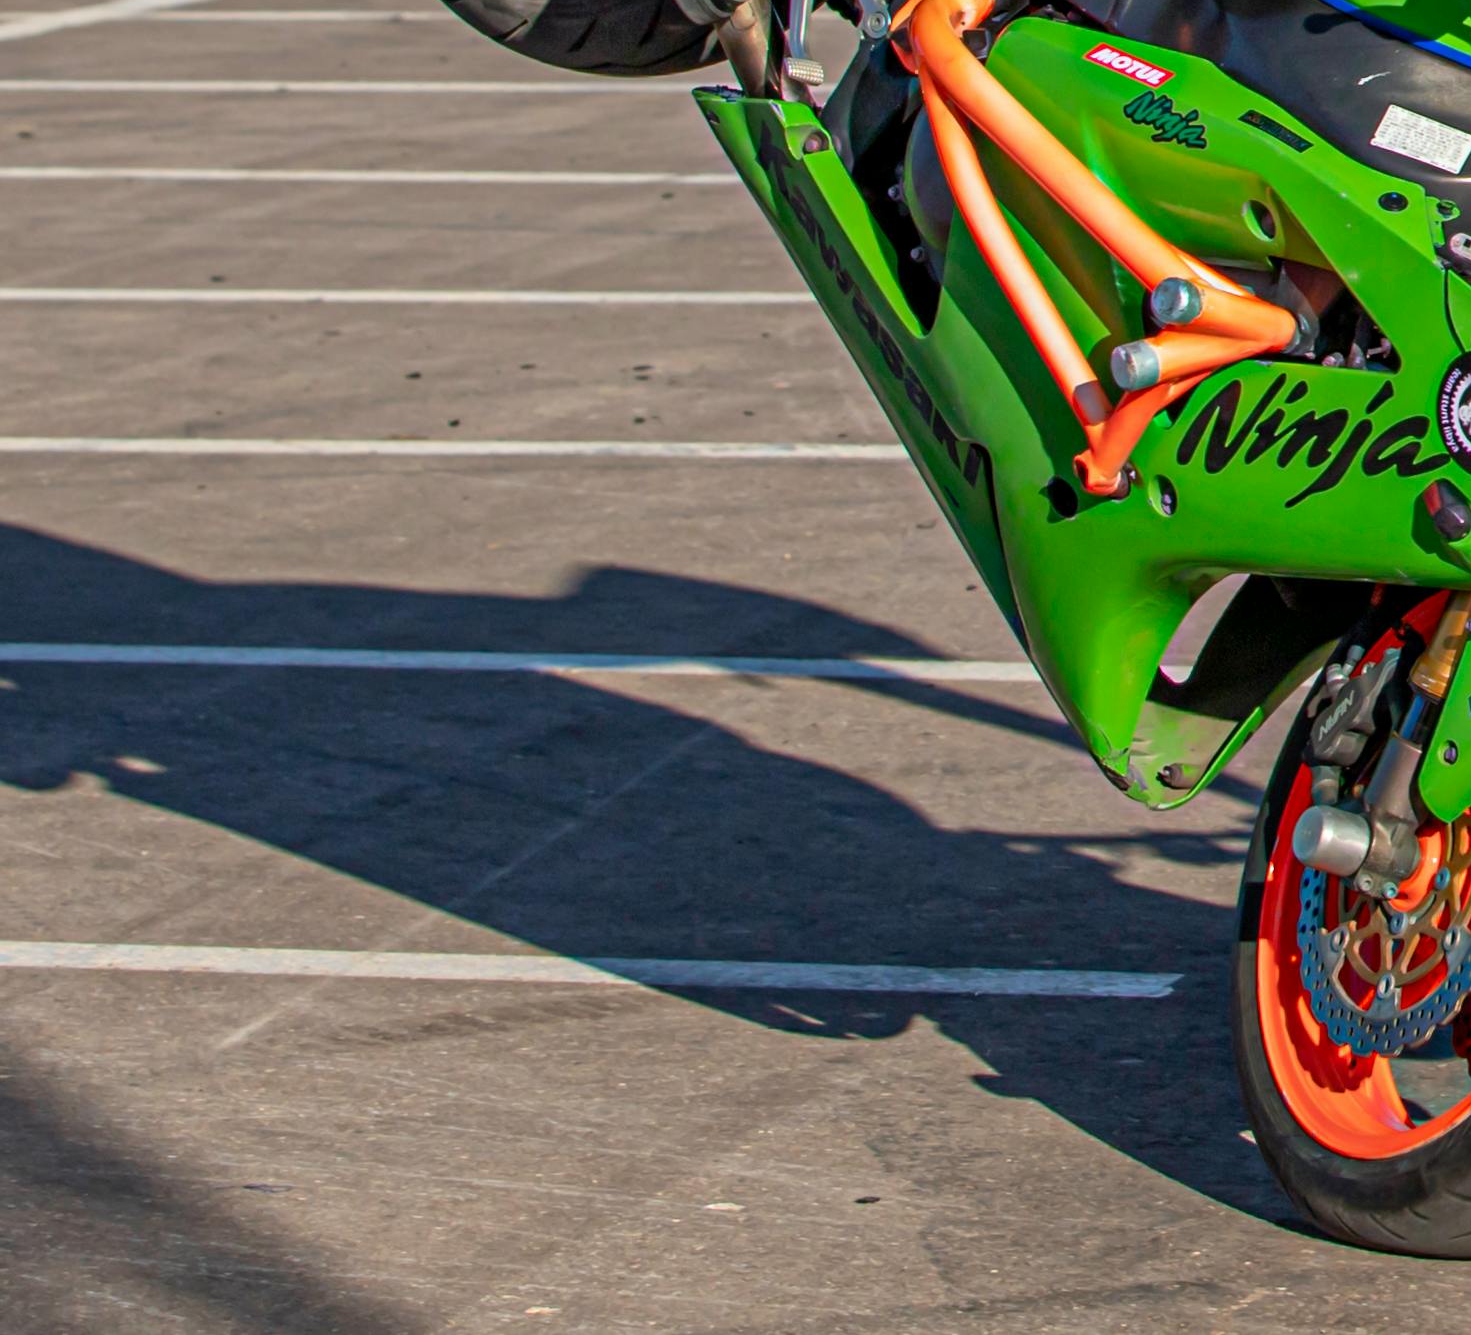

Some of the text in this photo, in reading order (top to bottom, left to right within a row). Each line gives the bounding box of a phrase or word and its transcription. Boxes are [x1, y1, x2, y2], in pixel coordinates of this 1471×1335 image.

[1089, 47, 1167, 85] MOTUL
[1123, 90, 1207, 149] Ninja
[1176, 372, 1451, 509] Ninja
[1440, 367, 1462, 453] team stunt libya
